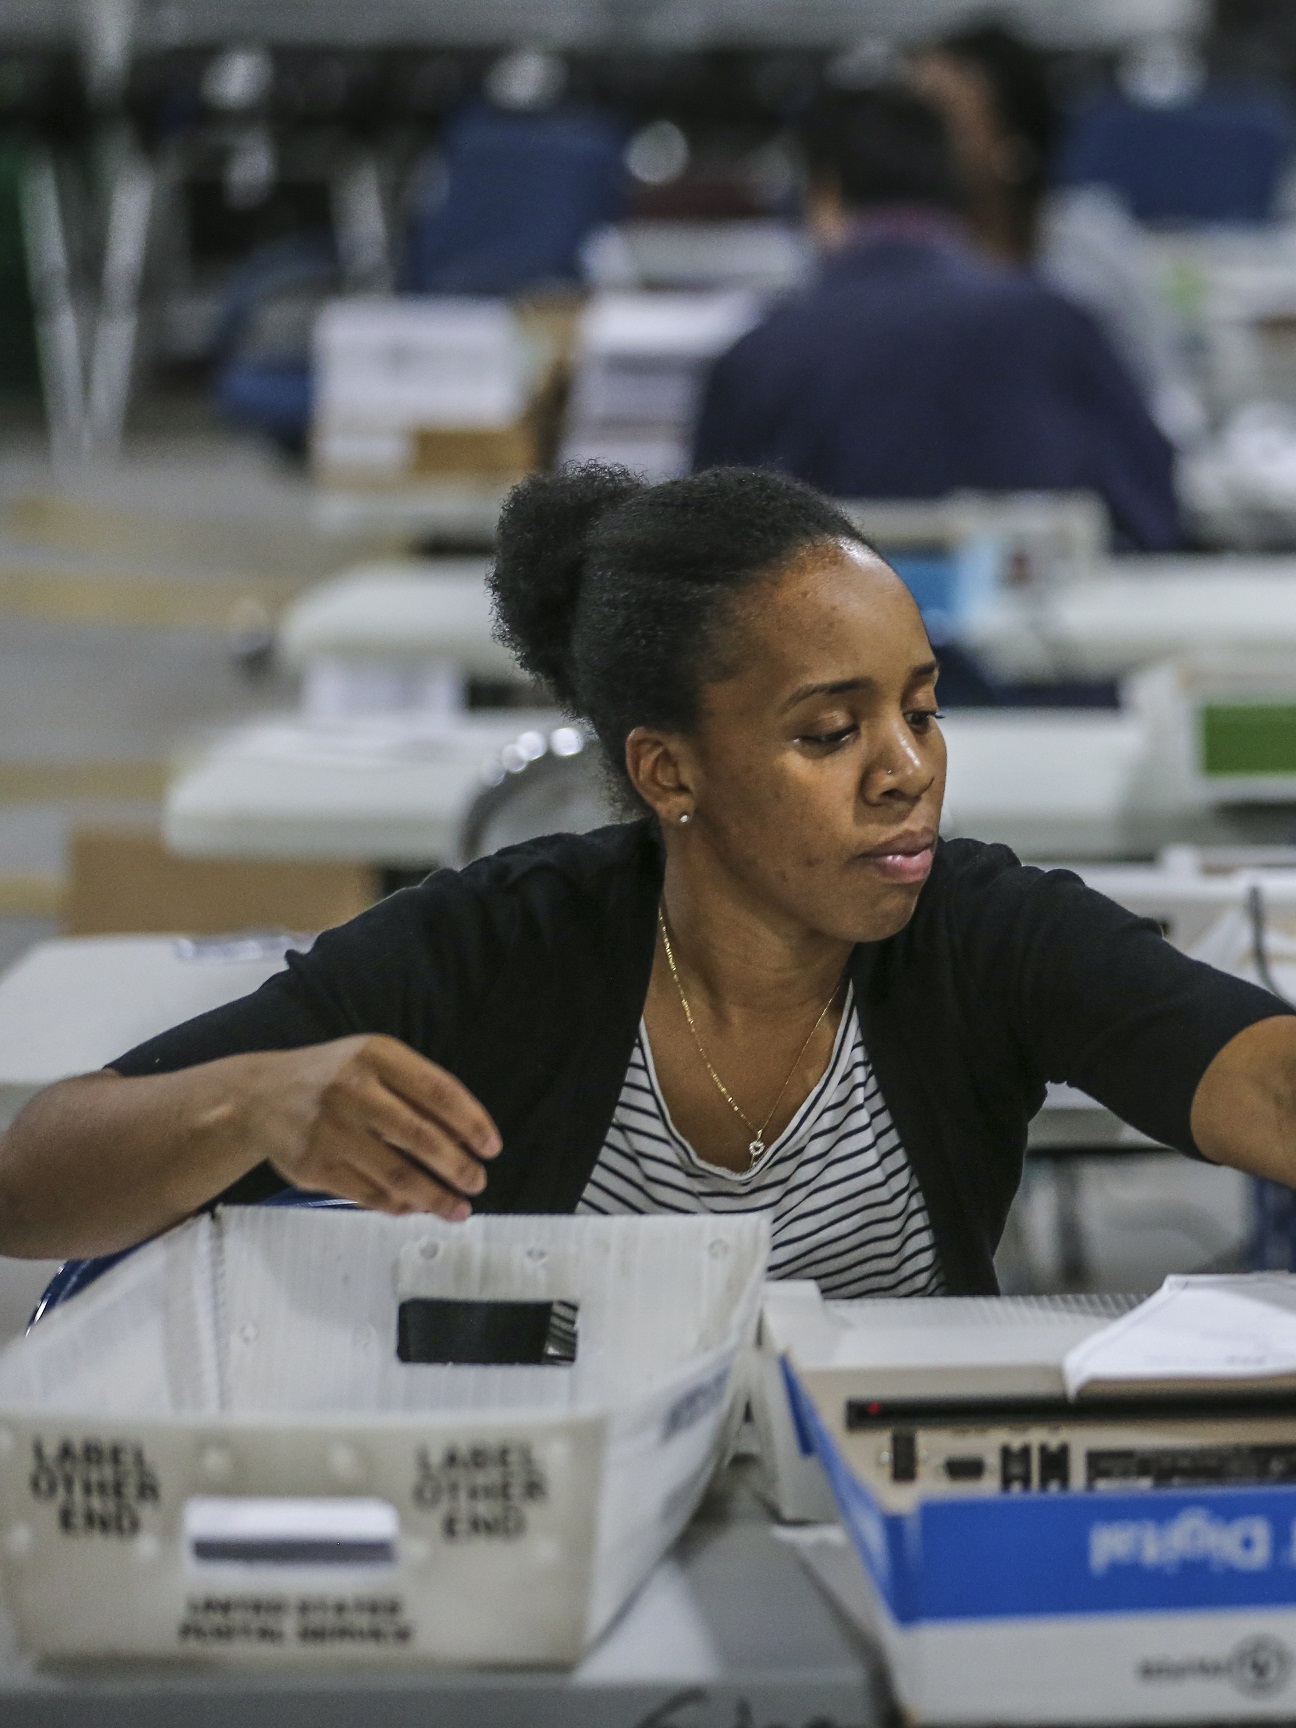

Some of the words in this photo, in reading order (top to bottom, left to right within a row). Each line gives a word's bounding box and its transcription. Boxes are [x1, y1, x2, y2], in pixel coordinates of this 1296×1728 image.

[31, 1435, 150, 1474] LABEL
[28, 1468, 161, 1505] OTHER
[58, 1501, 141, 1537] END
[441, 1504, 528, 1543] END
[1089, 1504, 1272, 1575] Digital
